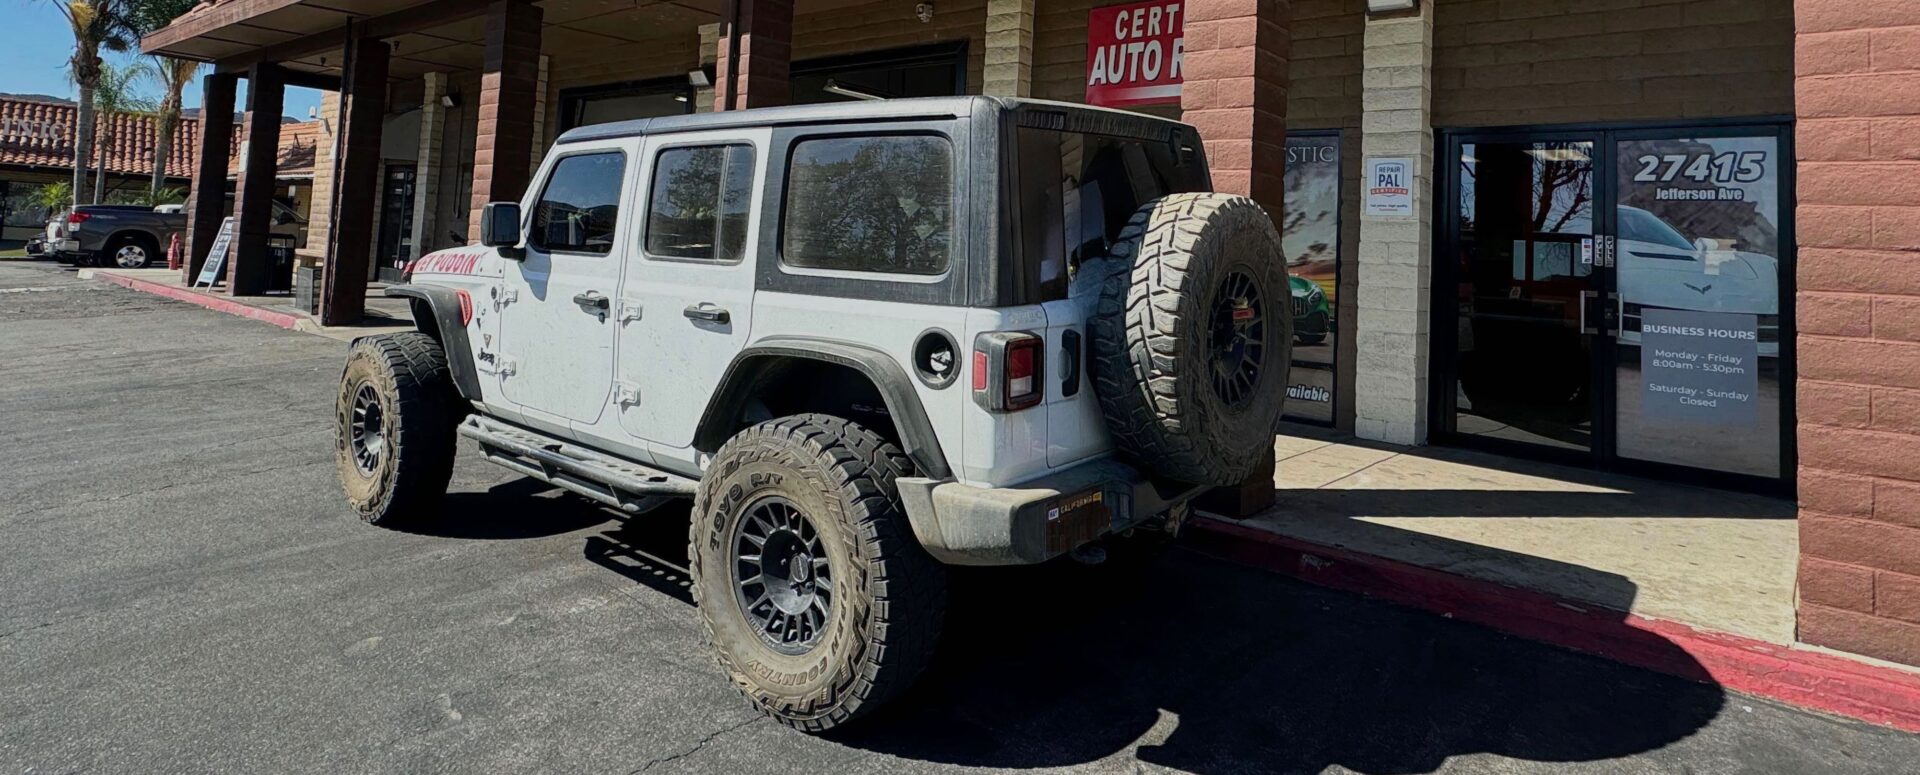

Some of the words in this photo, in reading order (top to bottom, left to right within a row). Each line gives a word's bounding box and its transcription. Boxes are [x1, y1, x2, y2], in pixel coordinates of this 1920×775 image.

[1115, 3, 1184, 40] CERT
[1089, 40, 1162, 86] AUTO
[1288, 146, 1334, 163] STIC
[1379, 166, 1401, 174] REPAIR
[1633, 152, 1766, 182] 27415
[1378, 174, 1400, 187] PAL
[1655, 188, 1716, 200] Jefferson
[1718, 188, 1743, 200] Ave
[1643, 324, 1705, 336] BUSINESS
[1708, 328, 1756, 340] HOURS
[1655, 349, 1698, 361] Monday
[1708, 353, 1742, 366] Friday
[1652, 359, 1693, 370] 8:00am
[1703, 363, 1744, 375] 5:30pm
[1649, 383, 1697, 397] Saturday
[1706, 388, 1749, 402] Sunday
[1679, 396, 1717, 408] Closed
[710, 483, 743, 551] TOYO
[750, 472, 783, 488] R/T
[746, 656, 828, 686] COUNTRY
